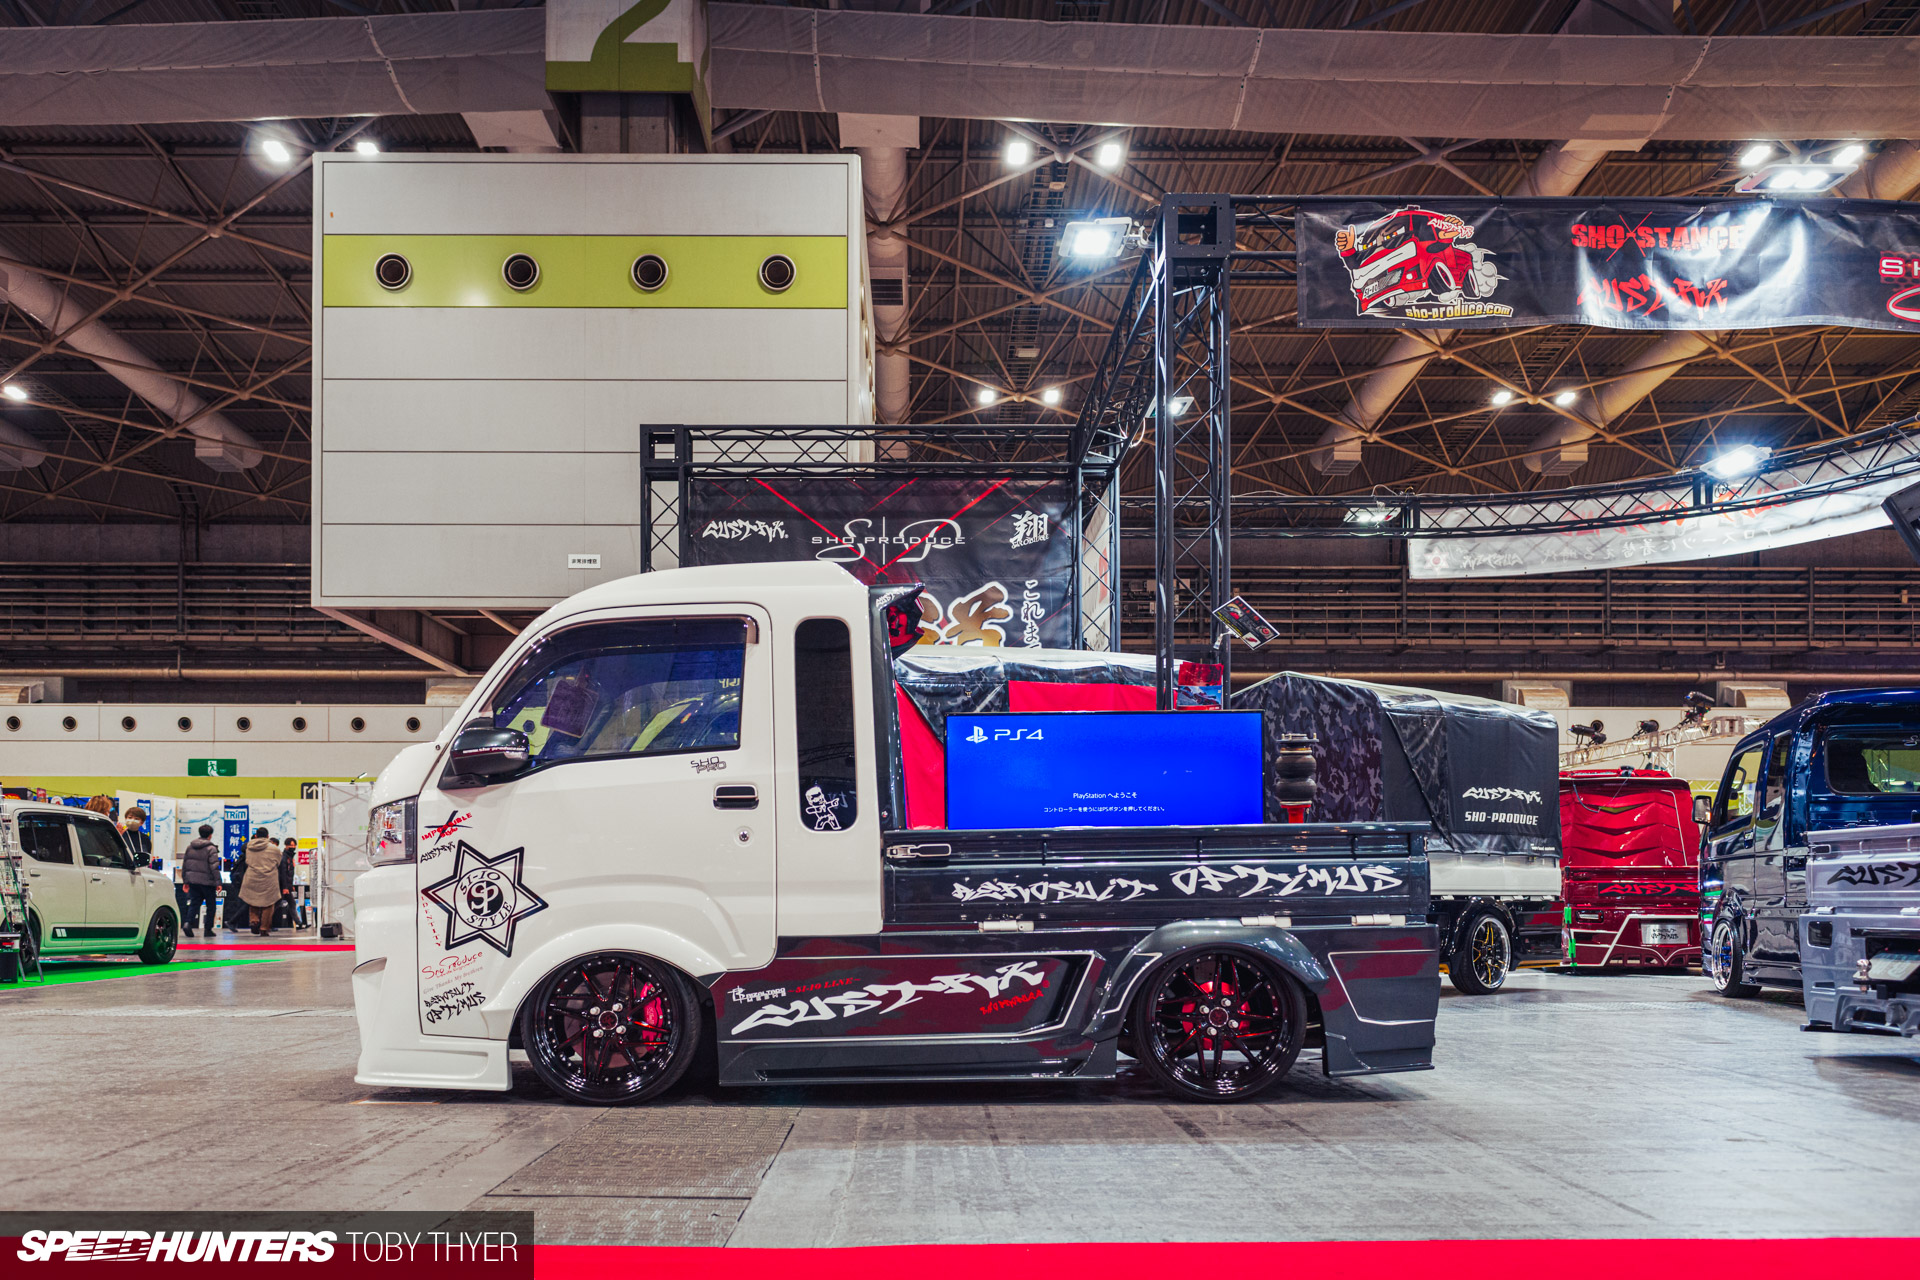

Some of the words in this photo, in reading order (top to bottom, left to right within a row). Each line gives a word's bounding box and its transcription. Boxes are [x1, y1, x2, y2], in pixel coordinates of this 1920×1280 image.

[1571, 224, 1625, 249] SHO
[1637, 226, 1746, 251] STANCE
[1405, 302, 1512, 319] sho-produce.com
[811, 536, 855, 544] SHO
[864, 536, 966, 545] PRODUCE
[994, 728, 1045, 741] PS4
[690, 756, 720, 768] SHO
[695, 760, 727, 774] PRO
[1073, 792, 1107, 800] PlayStation
[1464, 811, 1539, 826] SHO-PRODUCE
[466, 901, 513, 927] STYLE
